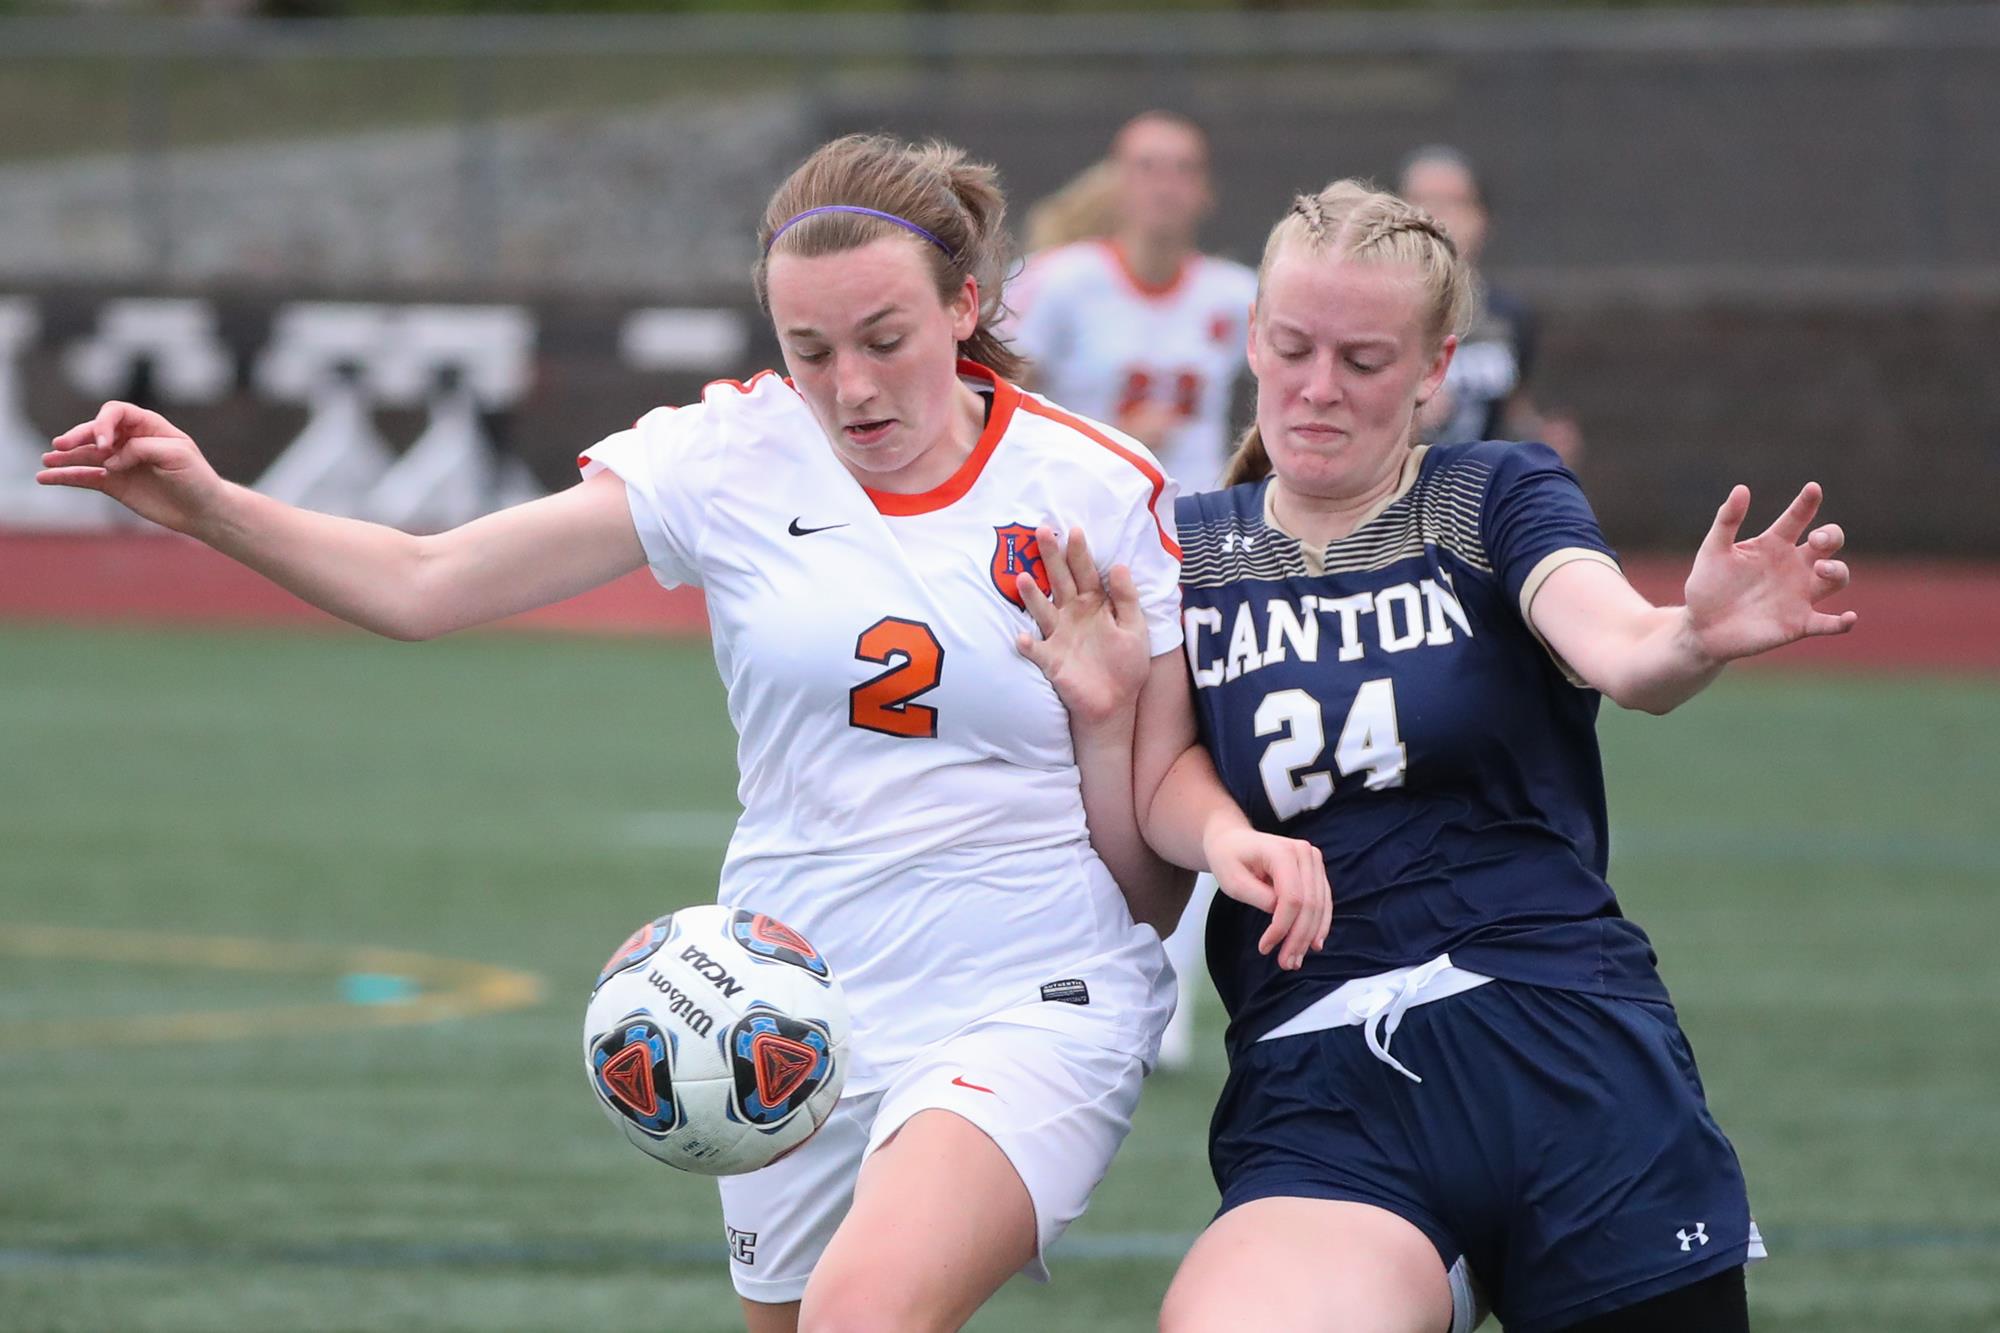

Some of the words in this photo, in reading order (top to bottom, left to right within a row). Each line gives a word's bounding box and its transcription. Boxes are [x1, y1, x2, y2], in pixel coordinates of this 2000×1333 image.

[849, 615, 946, 739] 2
[1184, 566, 1474, 689] CANTON
[1254, 677, 1407, 822] 24
[648, 969, 713, 1038] Wilson
[680, 944, 744, 998] NCAA
